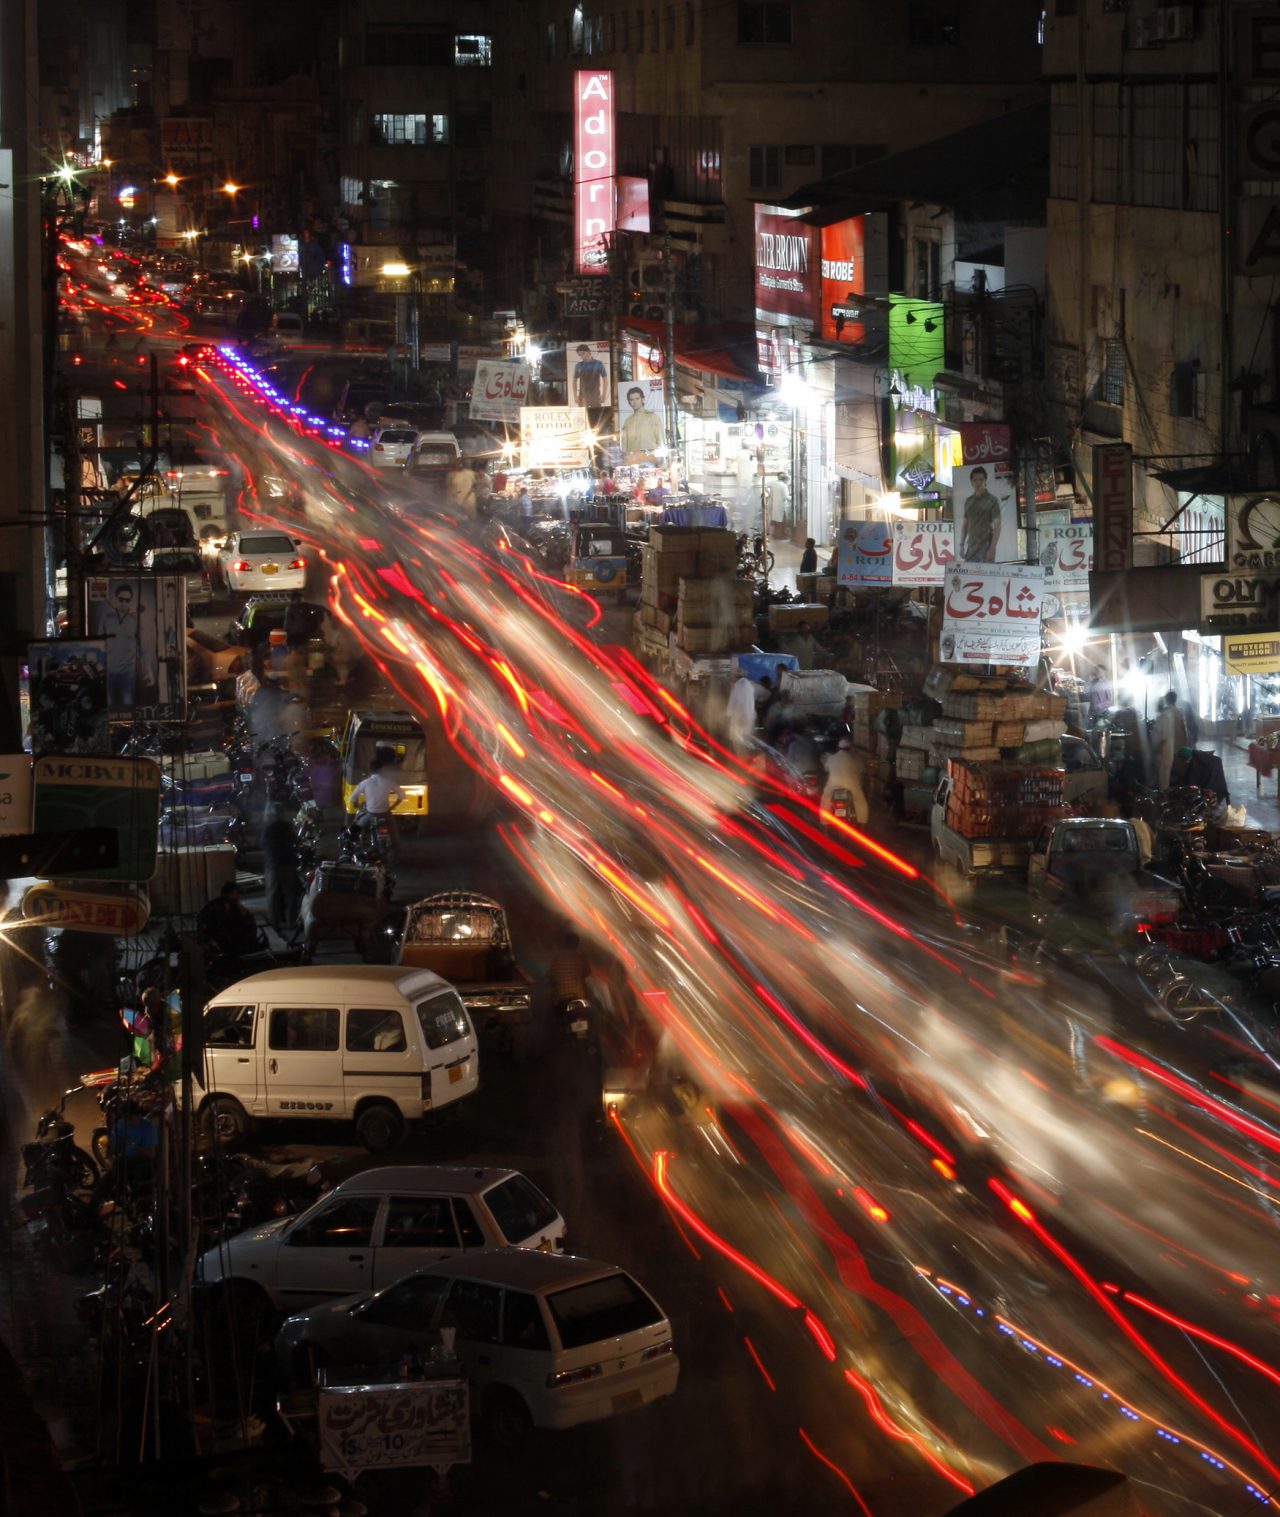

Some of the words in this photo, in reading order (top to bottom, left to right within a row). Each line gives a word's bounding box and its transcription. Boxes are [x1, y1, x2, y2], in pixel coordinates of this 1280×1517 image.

[582, 77, 608, 237] Adorn
[776, 235, 808, 273] BROWN
[535, 412, 571, 422] ROLEX
[946, 582, 987, 619] جی
[989, 578, 1039, 619] شاہ
[1231, 643, 1270, 651] WESTERN
[280, 1101, 333, 1111] HIROOF
